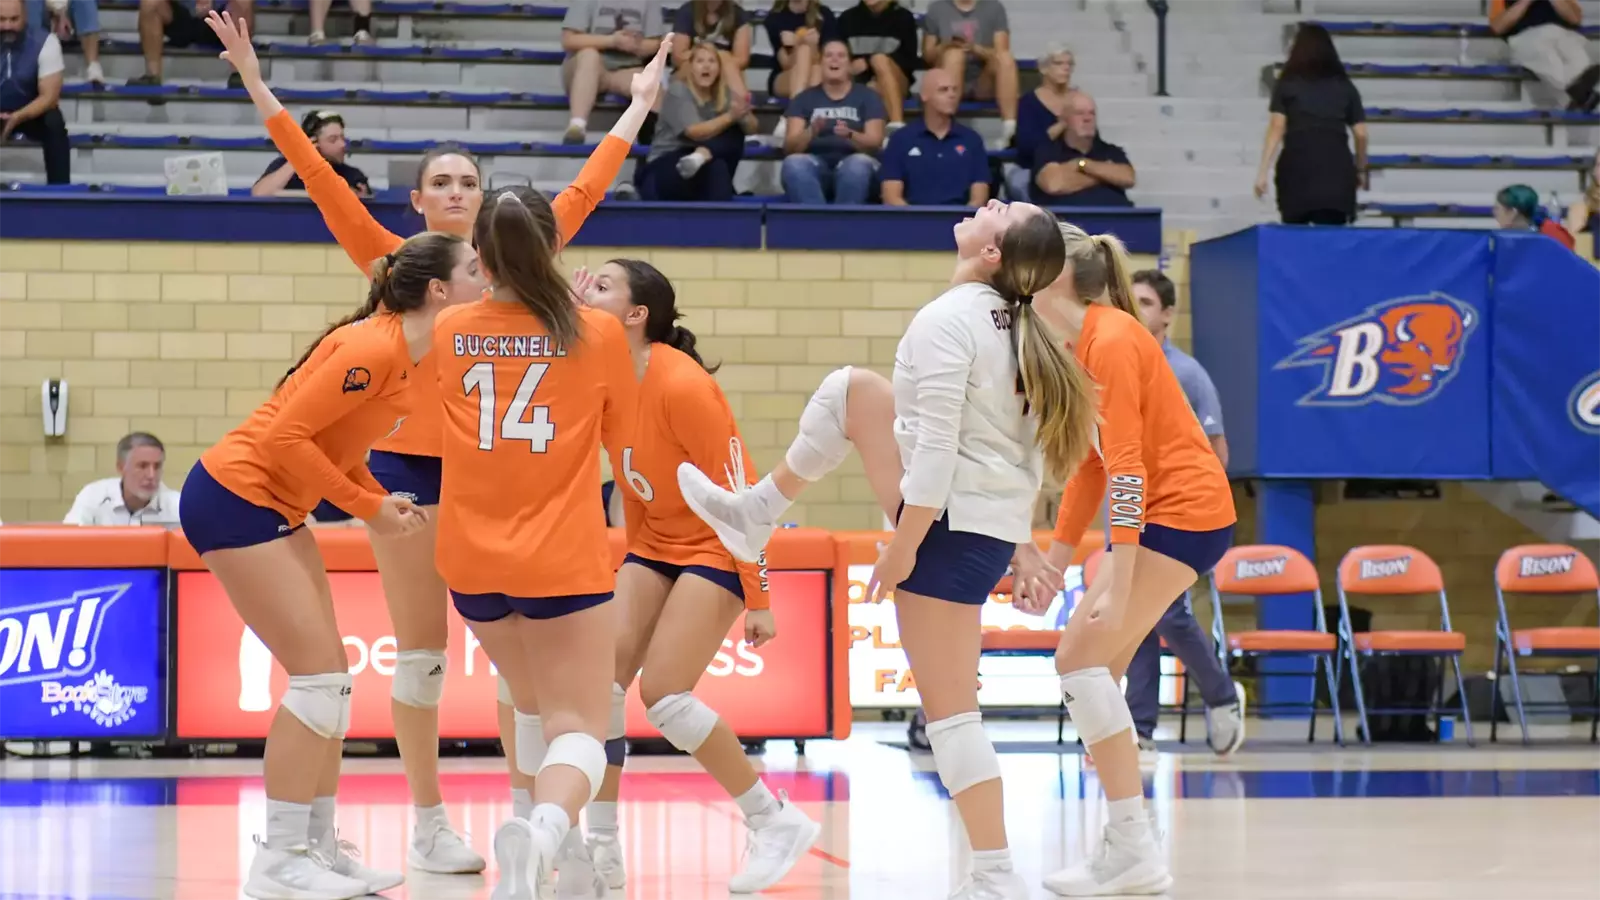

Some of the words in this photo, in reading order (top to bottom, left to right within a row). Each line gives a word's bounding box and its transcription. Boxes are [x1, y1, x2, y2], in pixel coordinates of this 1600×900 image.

[453, 333, 567, 357] BUCKNELL
[990, 309, 1013, 330] BUC
[1328, 322, 1384, 396] B
[461, 362, 555, 453] 14
[622, 446, 654, 502] 6
[1110, 474, 1144, 529] BISON
